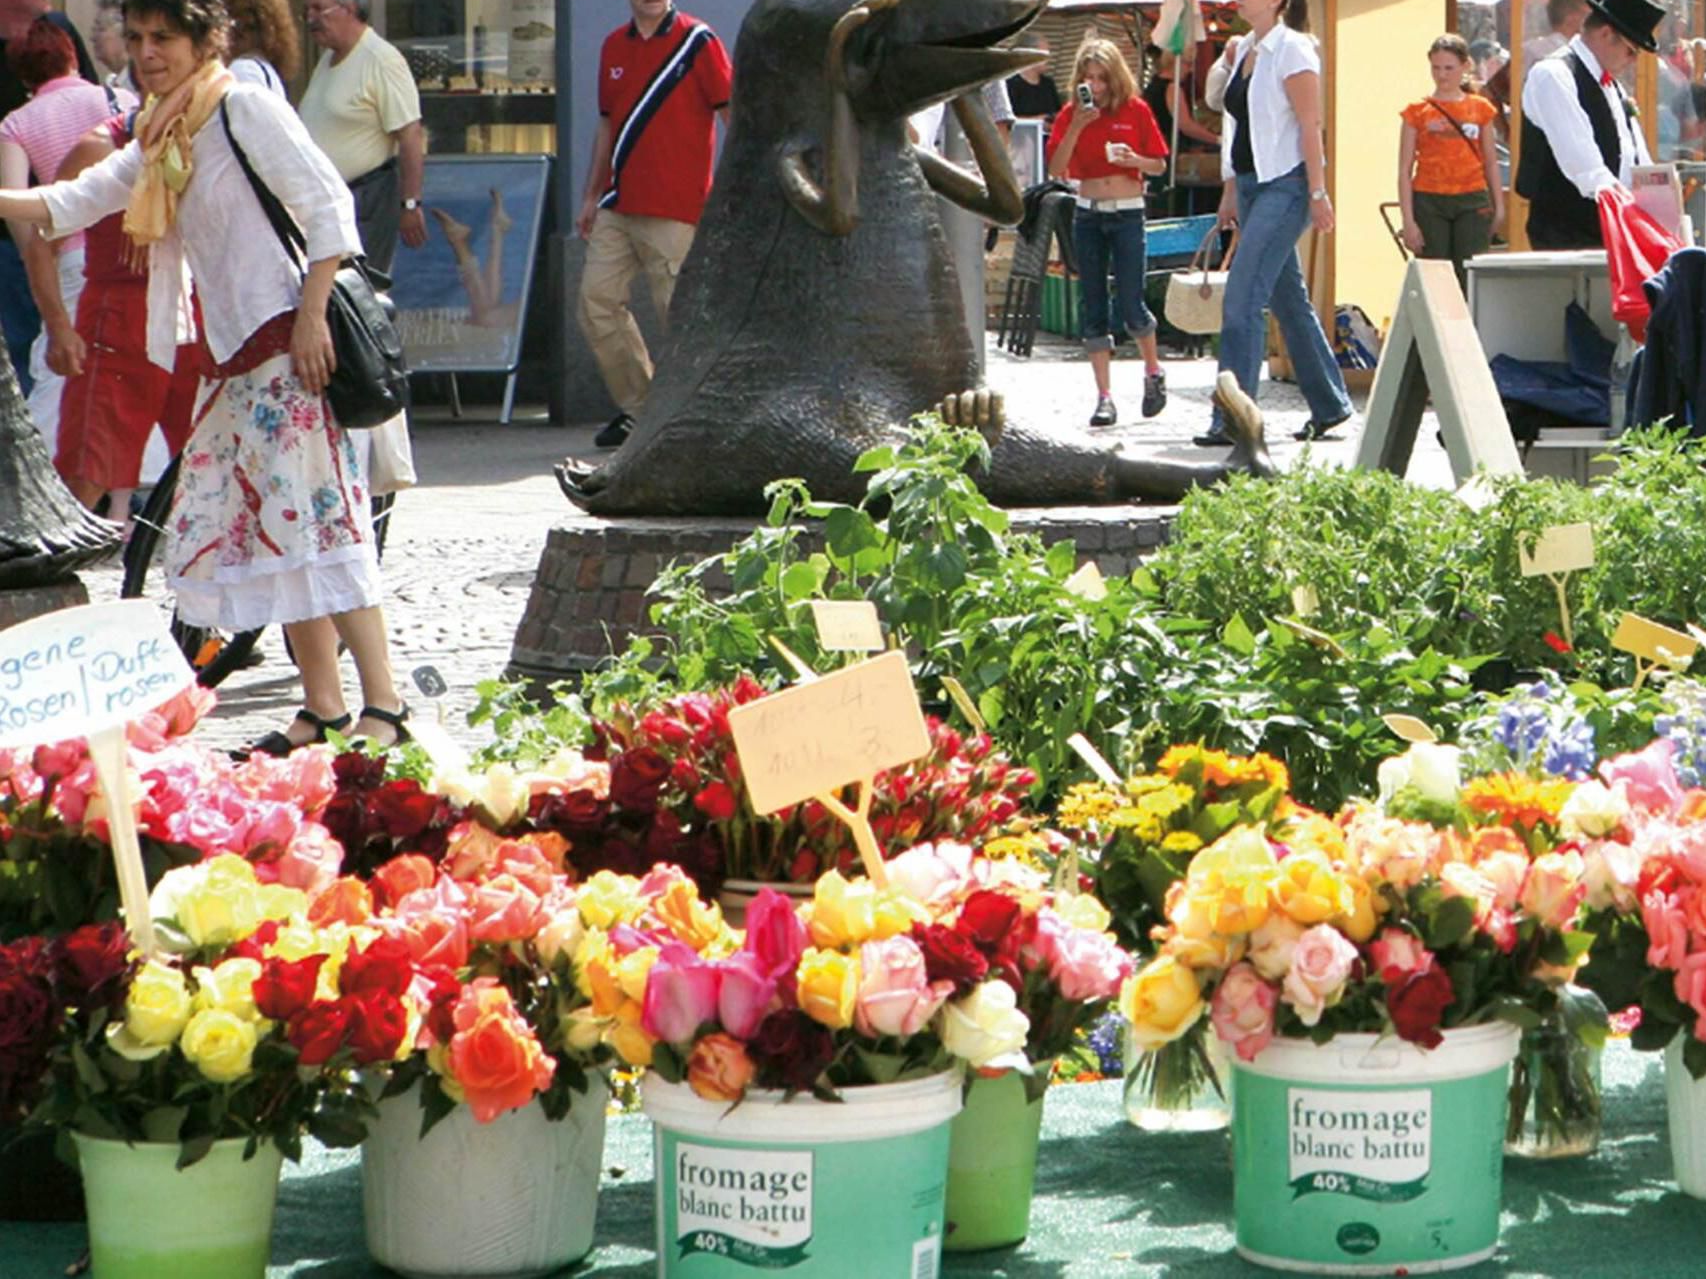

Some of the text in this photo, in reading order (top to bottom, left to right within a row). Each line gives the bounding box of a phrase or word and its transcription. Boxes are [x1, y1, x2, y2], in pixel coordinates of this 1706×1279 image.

[104, 671, 176, 713] rosen
[1293, 1098, 1427, 1137] fromage
[1293, 1132, 1425, 1160] blanc battu
[679, 1152, 807, 1200] fromage
[1312, 1174, 1351, 1193] 40%
[679, 1188, 805, 1223] blanc battu
[694, 1233, 729, 1254] 40%
